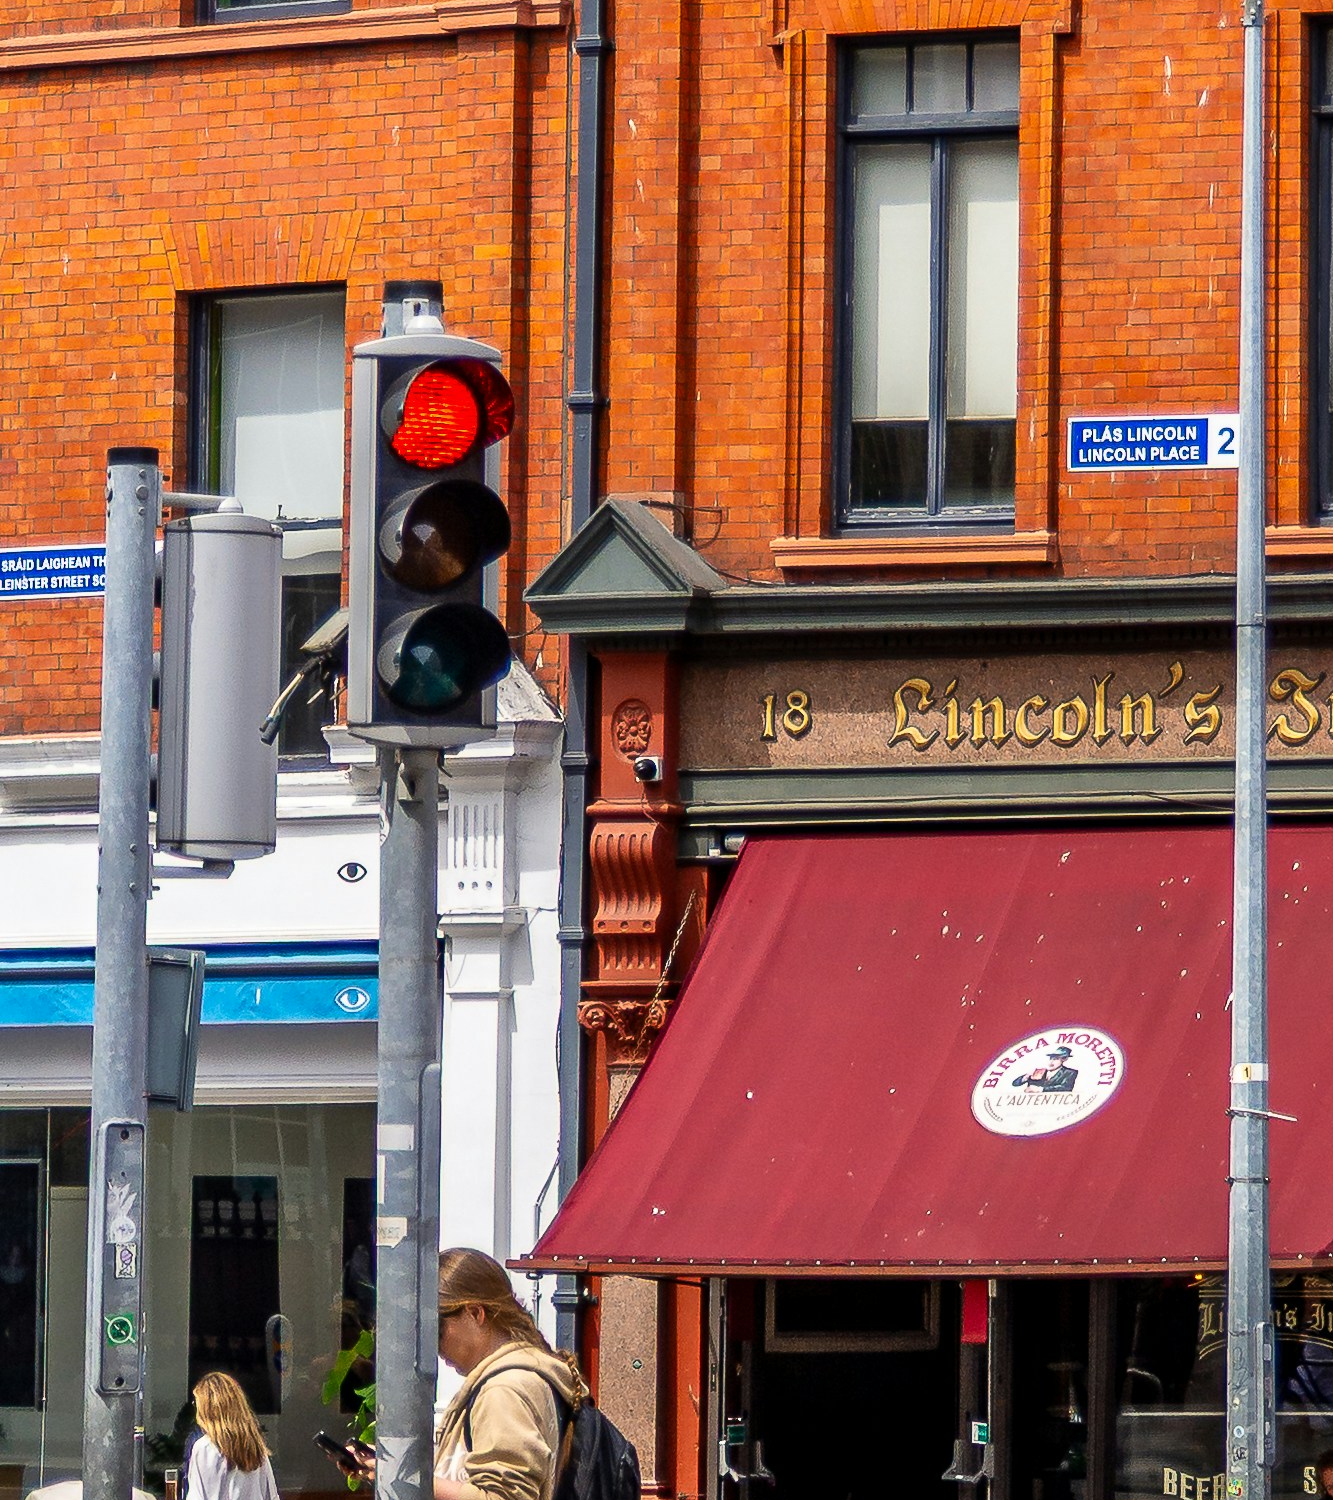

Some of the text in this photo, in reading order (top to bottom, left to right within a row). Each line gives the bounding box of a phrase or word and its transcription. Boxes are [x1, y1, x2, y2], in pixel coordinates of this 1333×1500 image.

[1082, 425, 1235, 455] PLÁS LINCOLN 2
[1079, 446, 1200, 462] LINCOLN PLACE
[1, 555, 107, 572] SRÁID LAIGHEAN TH
[0, 577, 49, 591] LEINSTER
[50, 574, 91, 589] STREET
[760, 689, 812, 742] 18
[888, 661, 1225, 751] Lincoln's
[983, 1032, 1117, 1089] BIRRA MORETTI
[995, 1092, 1081, 1108] L'AUTENTICA
